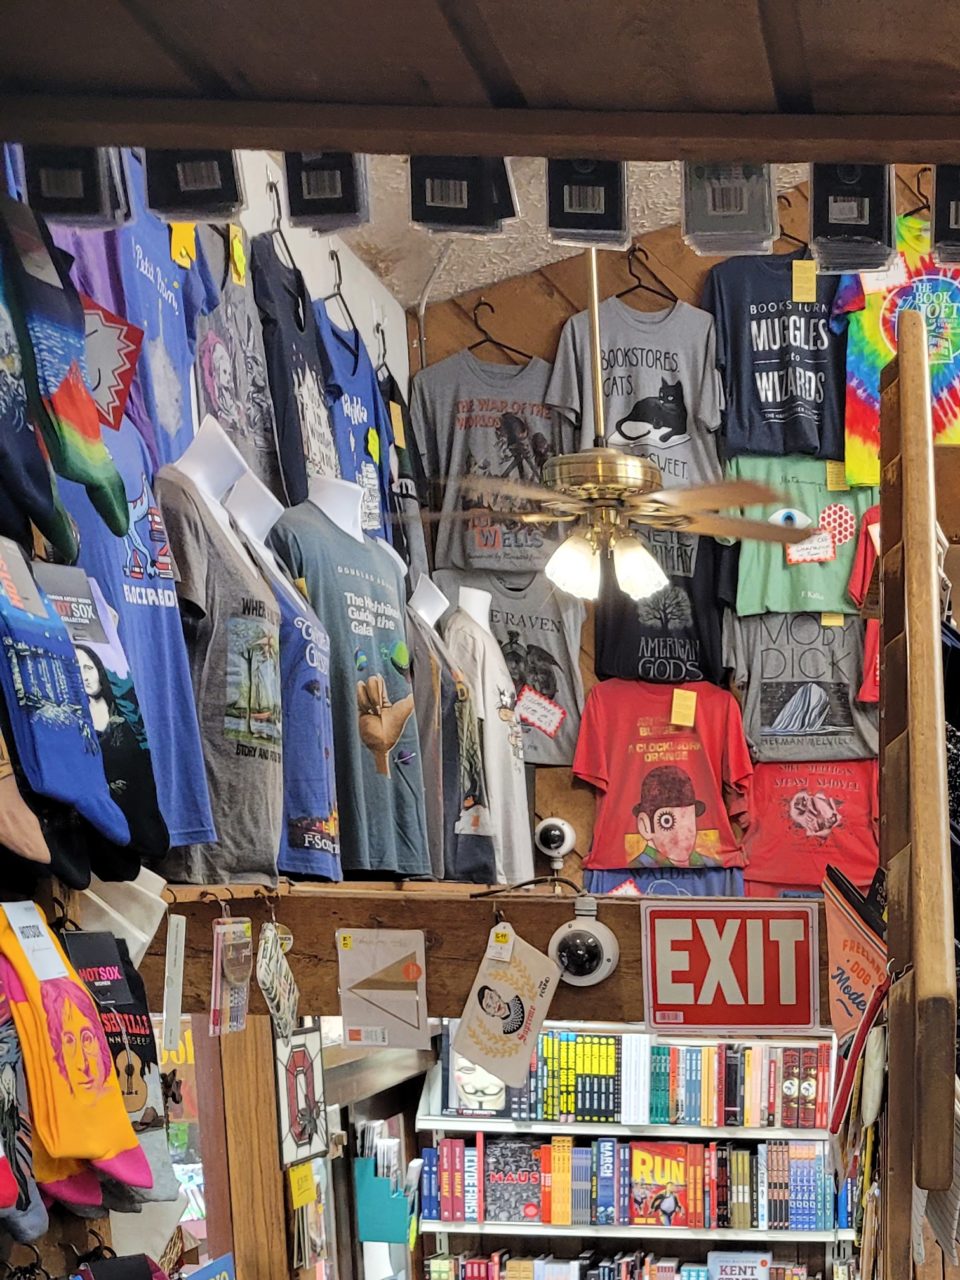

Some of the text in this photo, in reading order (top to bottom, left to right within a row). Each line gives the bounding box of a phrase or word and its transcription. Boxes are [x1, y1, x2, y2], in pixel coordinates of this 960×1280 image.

[912, 282, 932, 293] THE
[915, 292, 951, 303] BOOK
[750, 301, 792, 314] BOOKS
[750, 315, 829, 351] MUGGLES
[601, 348, 681, 374] BOOKSTORES.
[604, 376, 635, 397] CATS.
[755, 367, 825, 403] WIZARDS
[478, 399, 508, 414] WAR
[530, 403, 552, 419] THE
[456, 415, 501, 430] WORLDS
[649, 452, 689, 480] SWEET.
[480, 527, 544, 548] WELLS
[55, 601, 96, 619] OTSOX
[505, 612, 562, 633] RAVEN
[760, 614, 856, 647] MOBY
[639, 637, 700, 660] AMERICAN
[638, 658, 704, 681] GODS
[761, 648, 851, 680] DICK
[760, 736, 803, 746] HERMAN
[654, 918, 804, 1005] EXIT
[843, 939, 885, 981] FREELANC
[79, 966, 123, 981] HOTSOX
[831, 966, 867, 1012] Mode
[517, 1005, 537, 1043] Supreme
[603, 1142, 614, 1177] MARCH
[632, 1150, 685, 1186] RUN
[490, 1171, 540, 1184] MAUS
[719, 1265, 757, 1276] KENT
